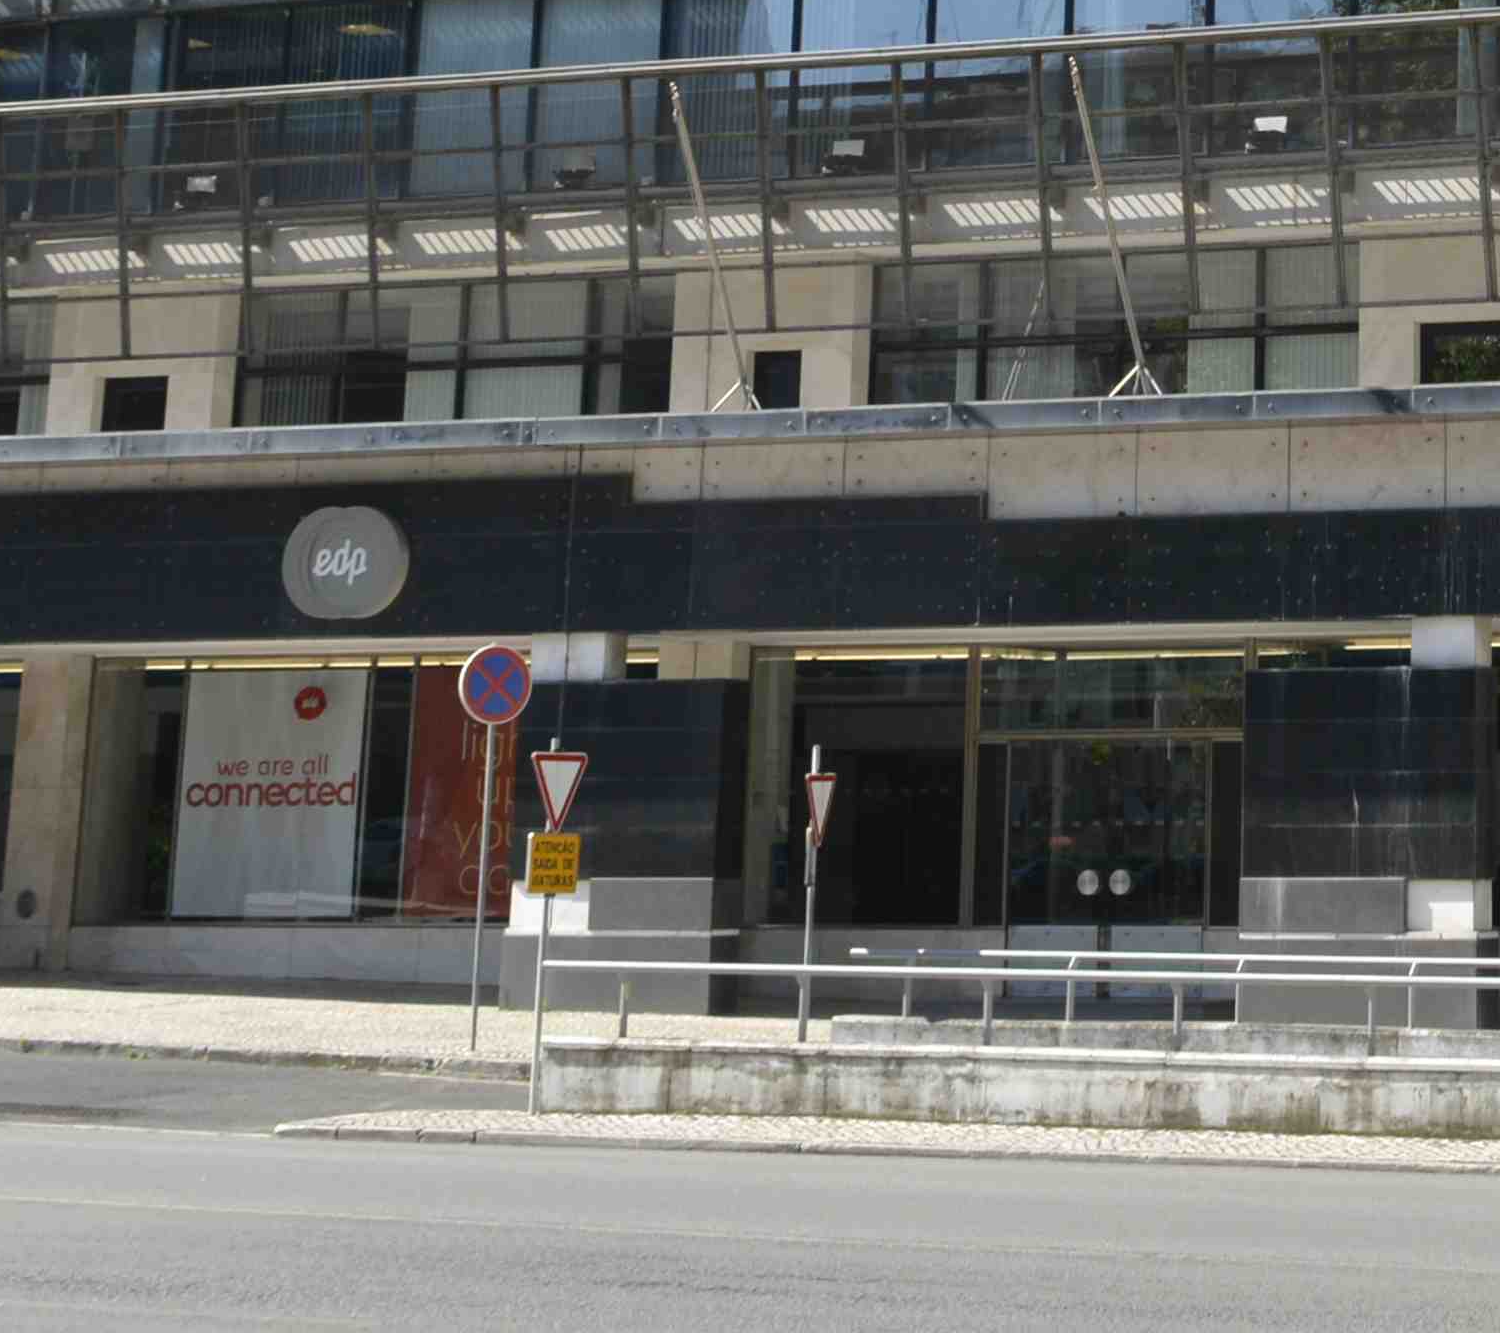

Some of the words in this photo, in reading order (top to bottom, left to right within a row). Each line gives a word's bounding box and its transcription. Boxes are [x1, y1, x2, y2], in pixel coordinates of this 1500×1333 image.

[312, 537, 368, 586] edp
[217, 759, 250, 777] we
[257, 758, 295, 776] are
[301, 753, 329, 776] all
[185, 772, 357, 808] connected
